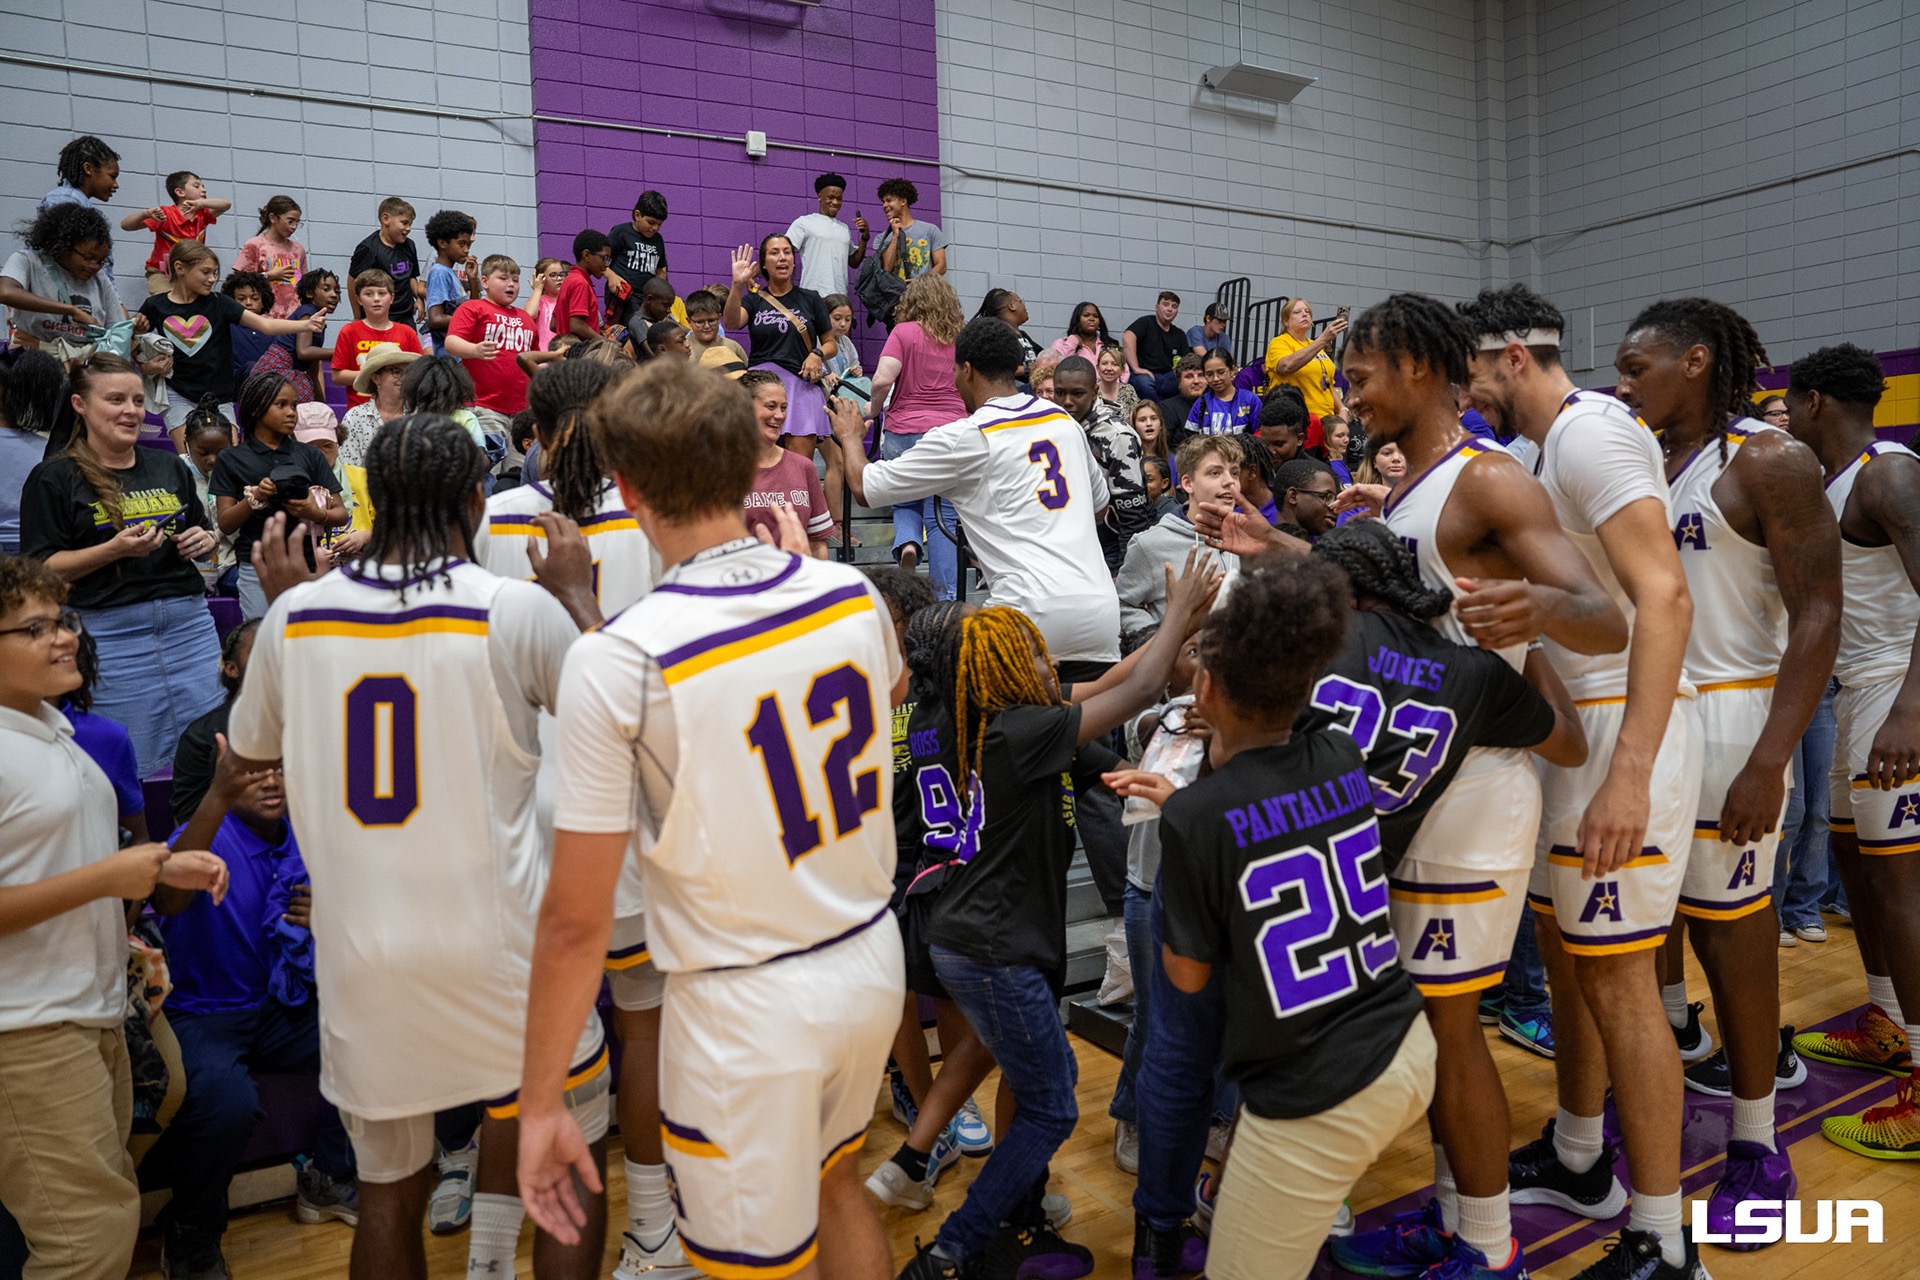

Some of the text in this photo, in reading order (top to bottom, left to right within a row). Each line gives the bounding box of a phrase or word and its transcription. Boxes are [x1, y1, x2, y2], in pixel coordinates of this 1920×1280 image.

[635, 242, 657, 254] TRIBE
[390, 261, 409, 275] LSU
[494, 313, 523, 327] TRIBE
[1028, 438, 1071, 512] 3
[743, 489, 810, 509] GAME ON
[1368, 645, 1445, 692] JONES
[343, 672, 421, 828] 0
[909, 728, 941, 758] ROSS
[743, 659, 882, 870] 12
[1238, 816, 1400, 1019] 25
